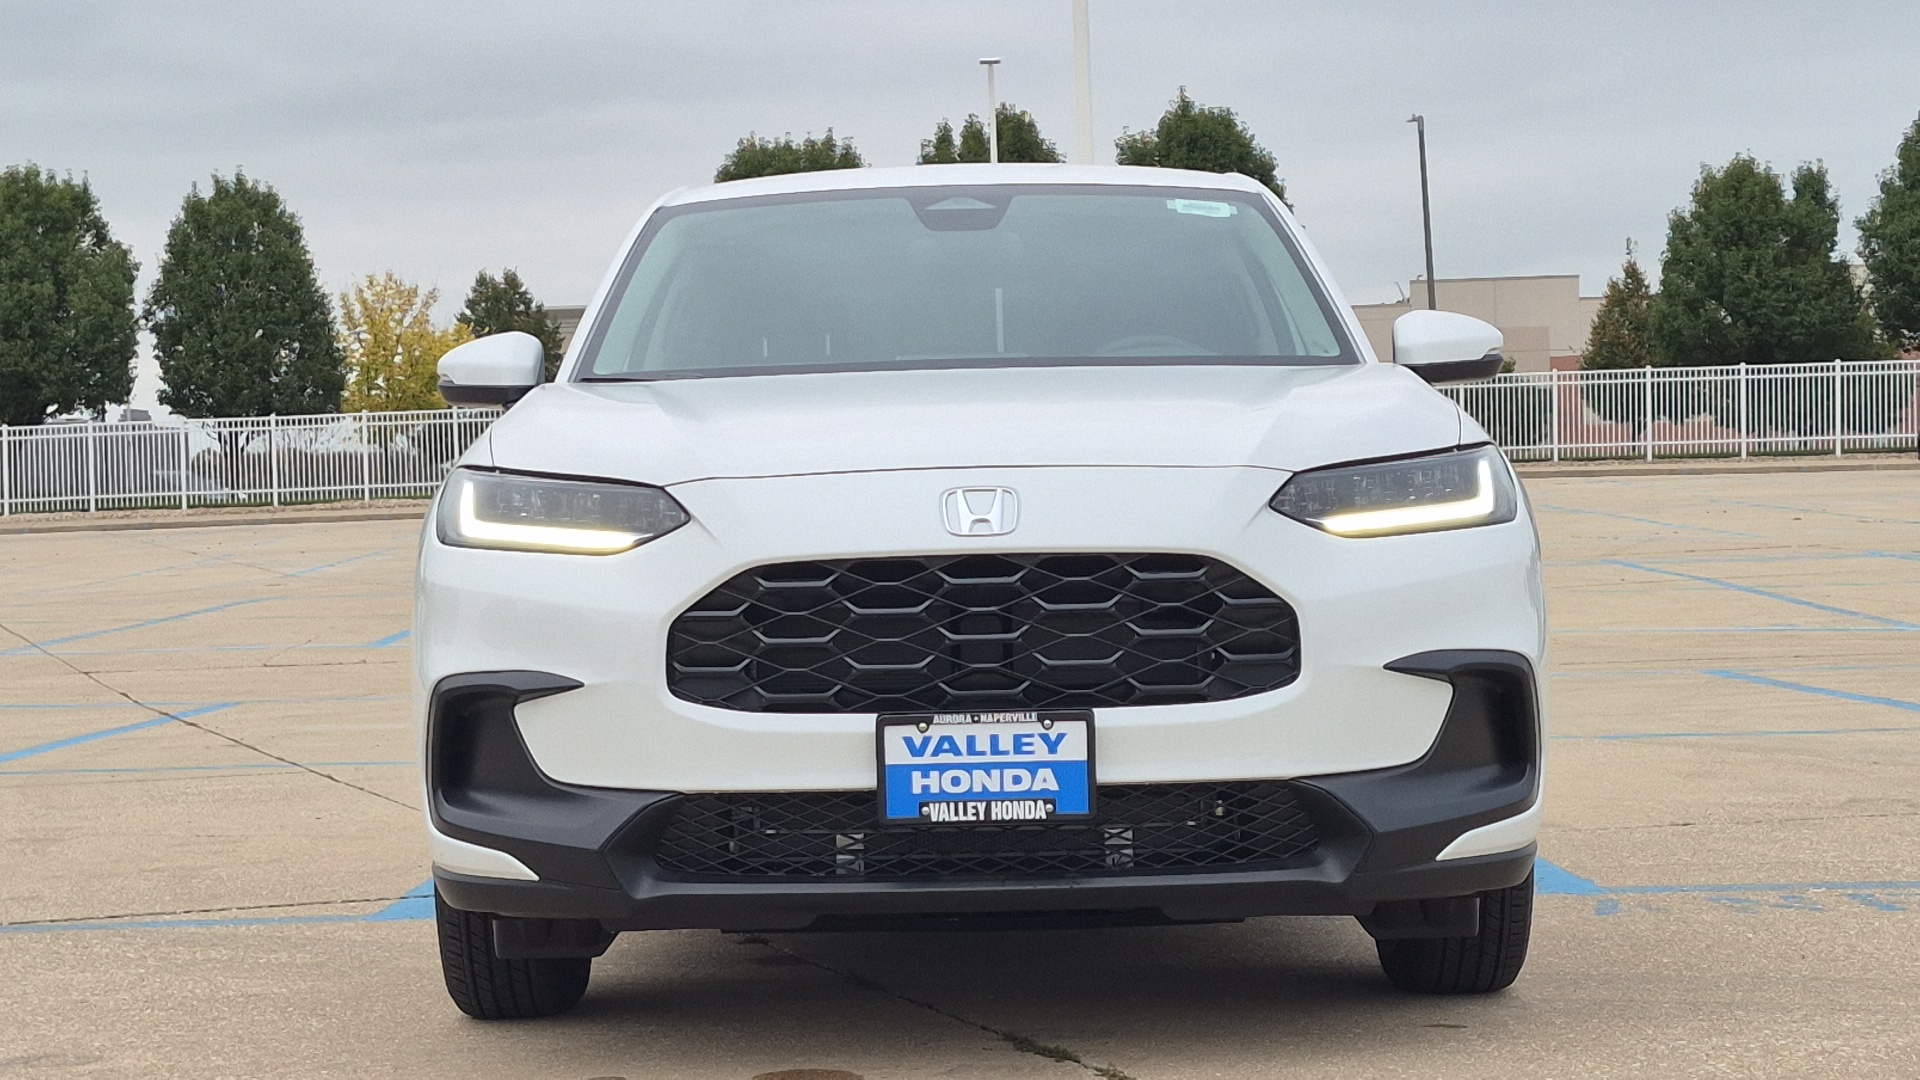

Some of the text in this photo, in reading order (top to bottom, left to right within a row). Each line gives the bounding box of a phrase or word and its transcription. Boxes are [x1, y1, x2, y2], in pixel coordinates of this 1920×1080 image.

[933, 712, 1038, 724] AURORA NAPERVILLE
[902, 733, 1068, 757] VALLEY
[911, 768, 1059, 794] HONDA
[929, 800, 1047, 822] VALLEY HONDA
